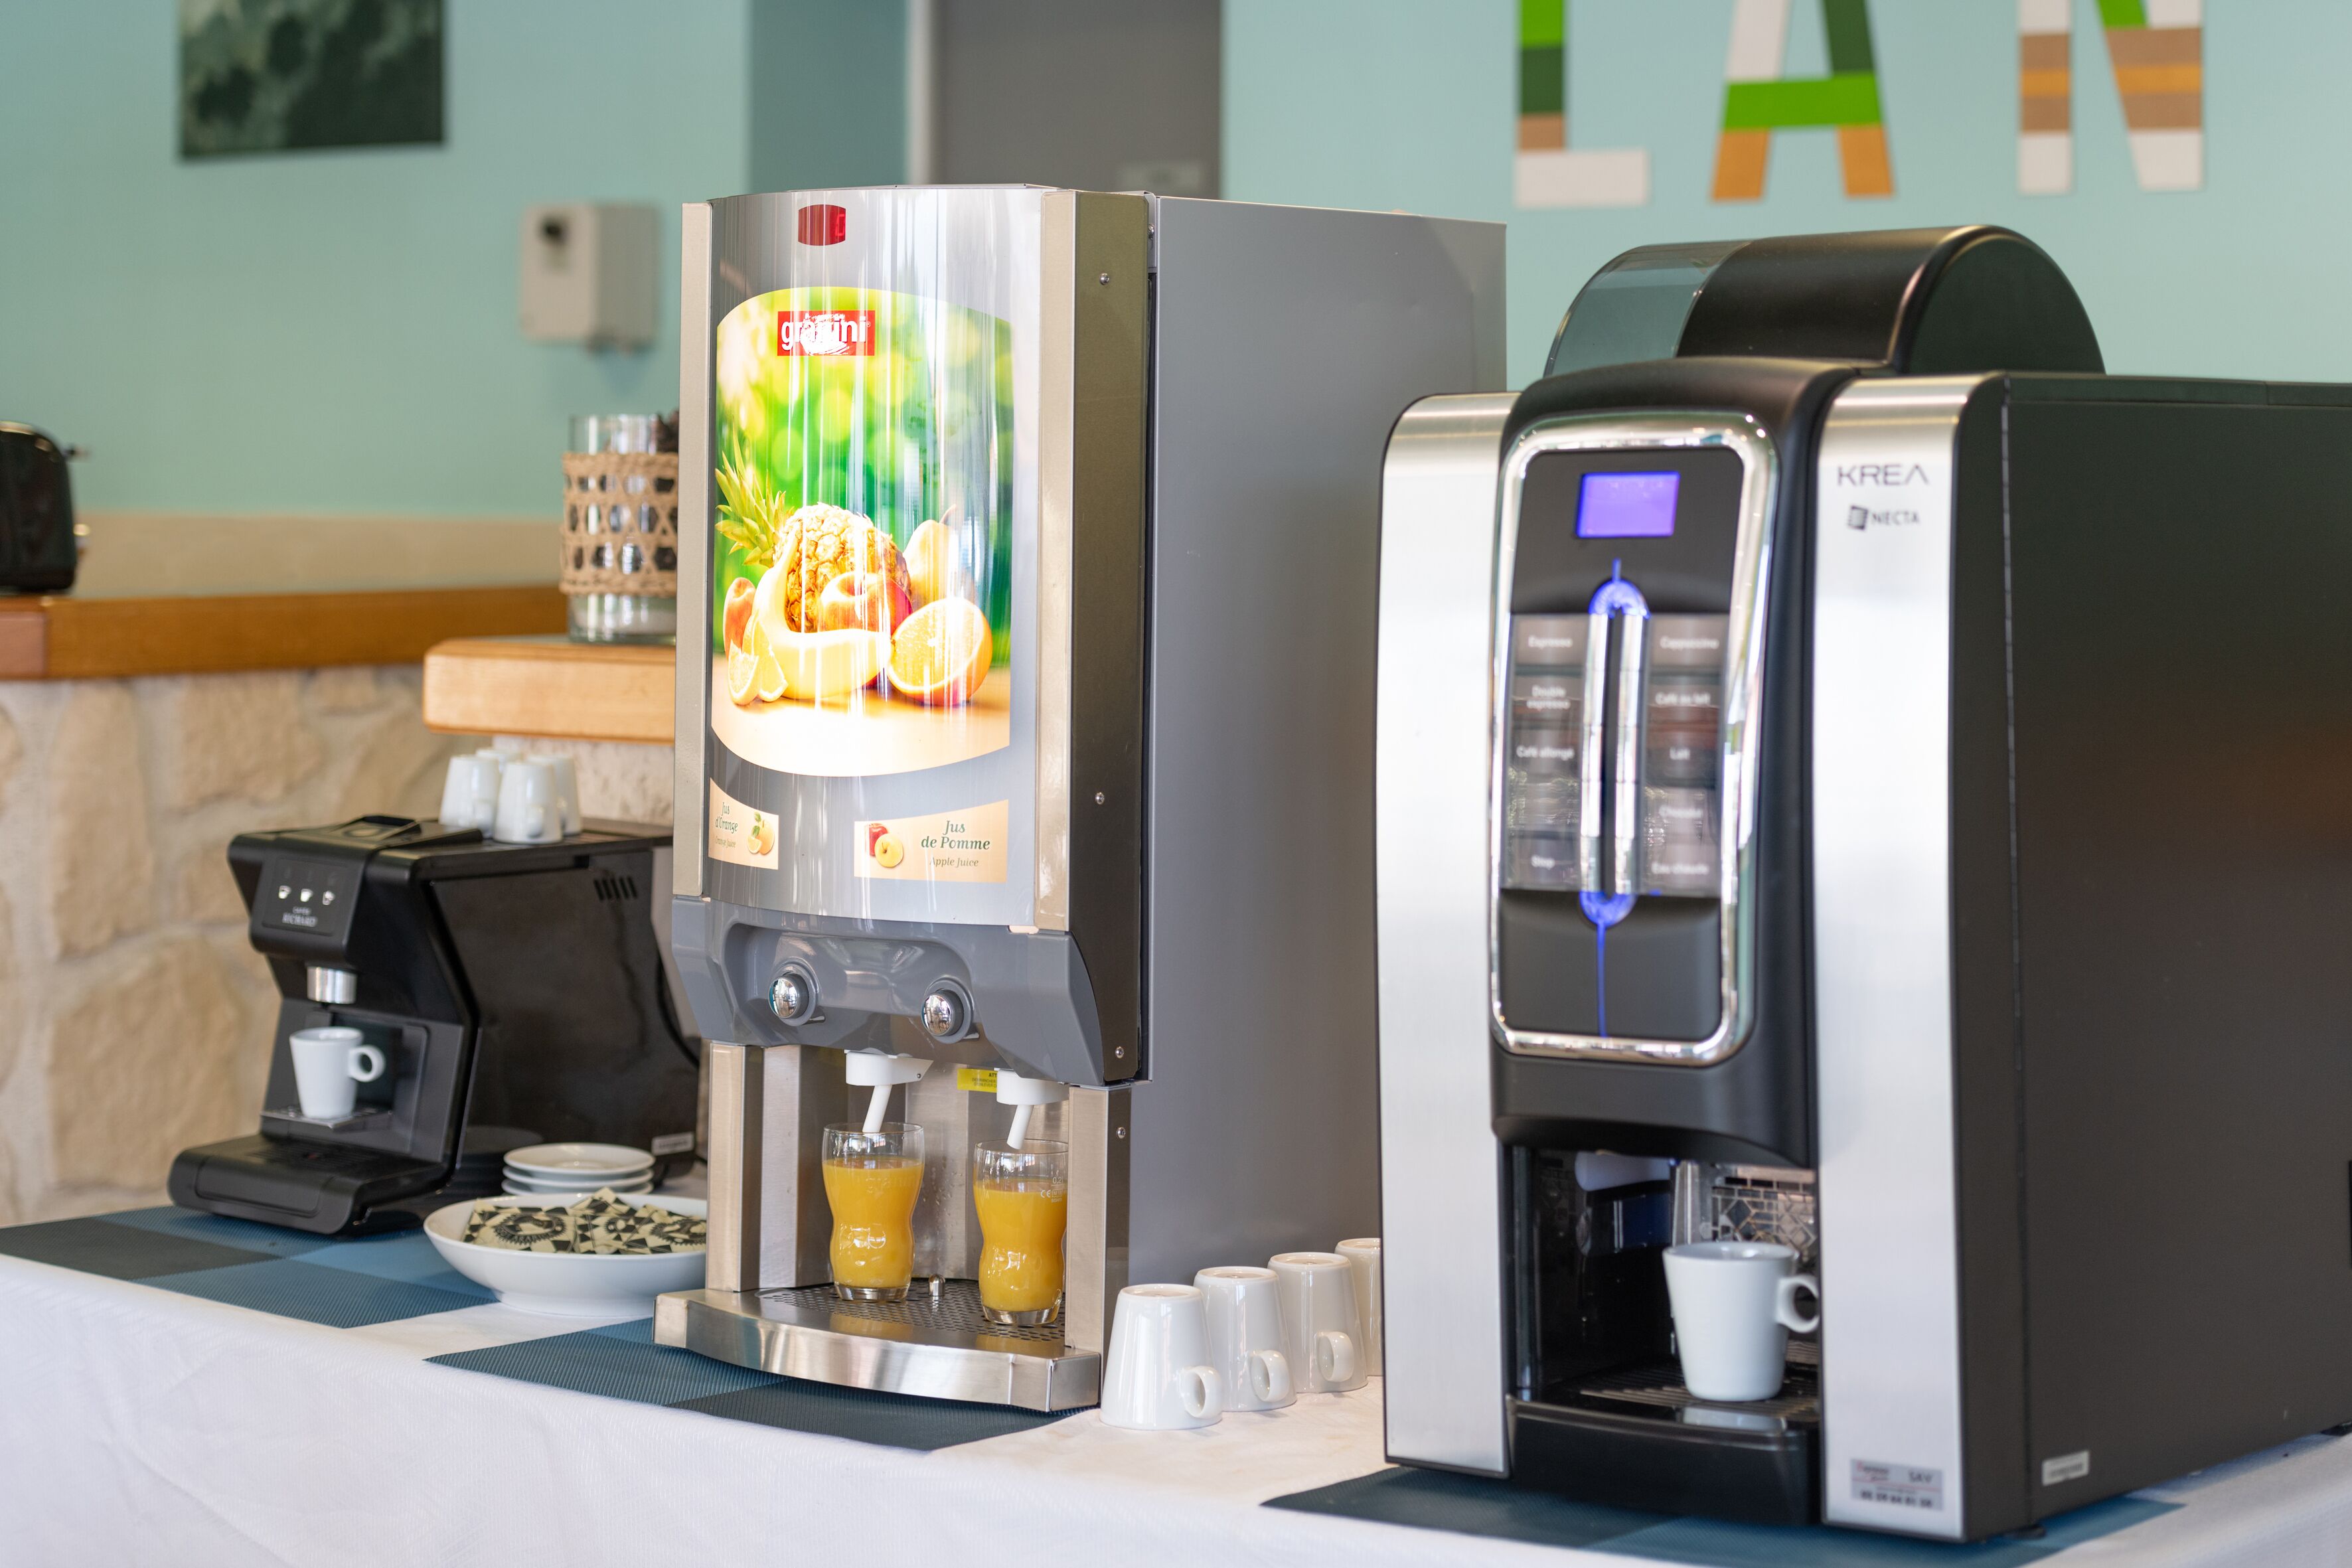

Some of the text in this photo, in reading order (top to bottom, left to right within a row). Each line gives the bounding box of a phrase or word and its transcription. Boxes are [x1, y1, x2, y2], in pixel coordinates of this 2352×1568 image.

[1837, 464, 1929, 486] KREA
[721, 801, 730, 817] Jus
[714, 815, 738, 834] d'Orange
[942, 820, 966, 836] Jus
[921, 835, 990, 850] de Pomme
[929, 857, 979, 868] Apple Juice
